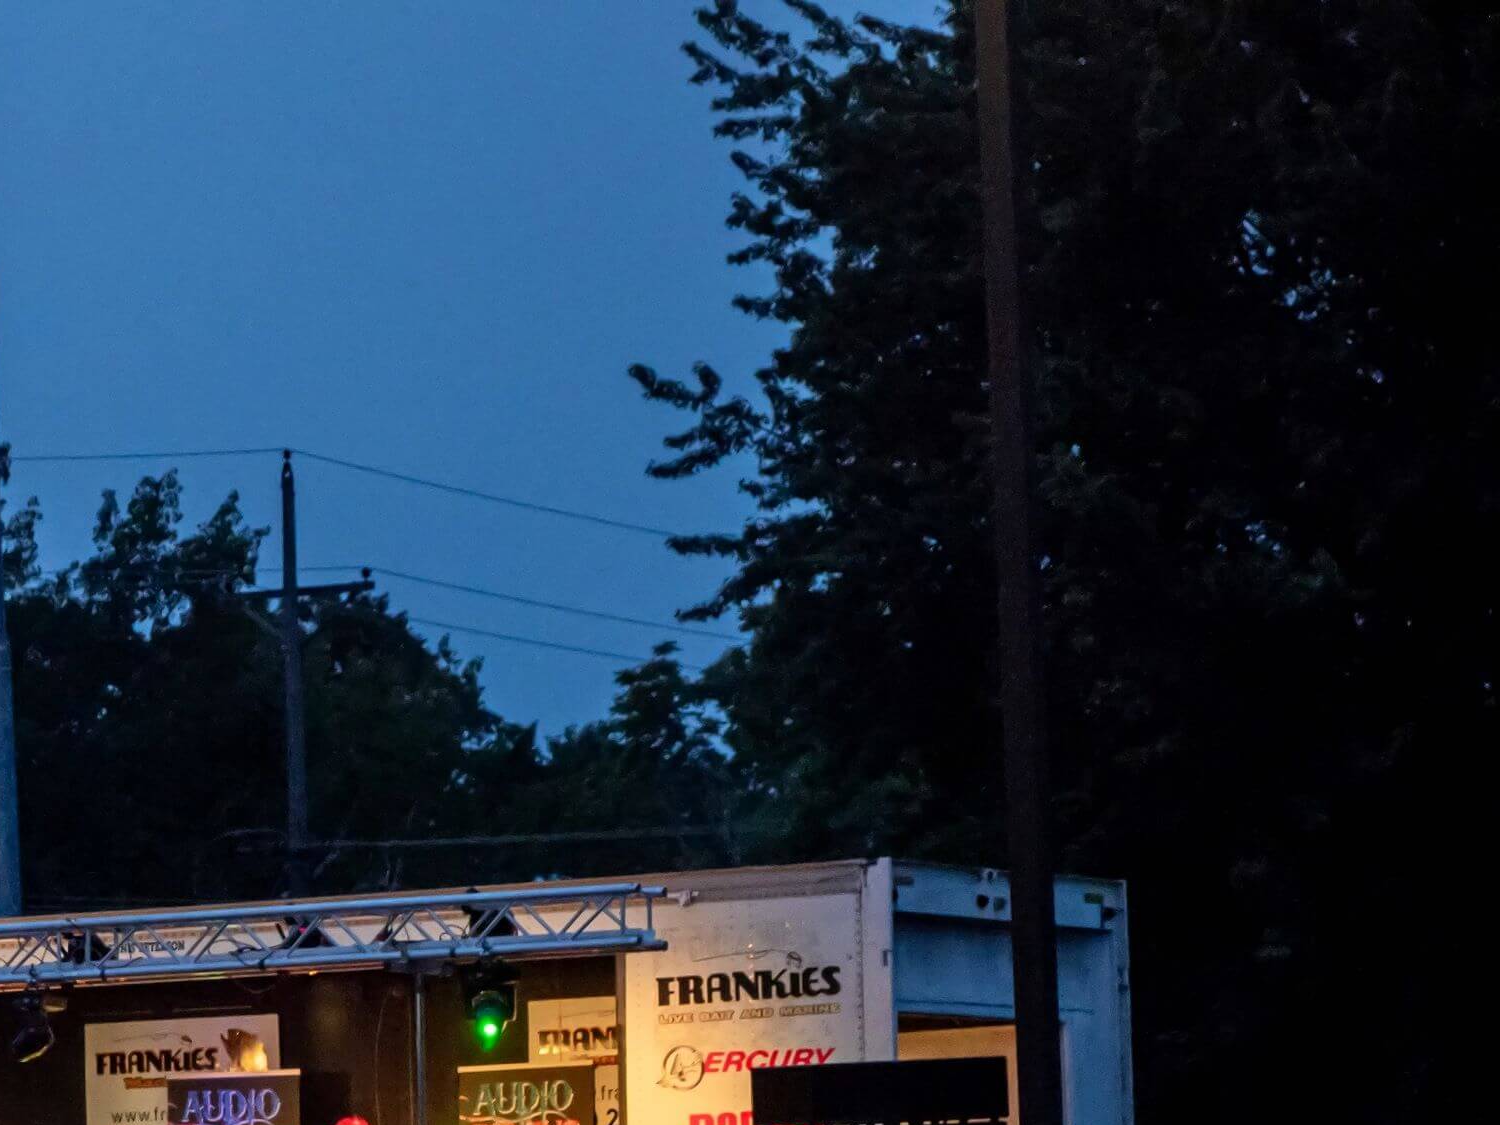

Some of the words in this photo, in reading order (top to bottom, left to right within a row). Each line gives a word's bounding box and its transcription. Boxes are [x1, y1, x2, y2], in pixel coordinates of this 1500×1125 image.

[740, 1007, 774, 1019] AND
[181, 1088, 281, 1123] AUDIO
[472, 1080, 574, 1116] AUDIO
